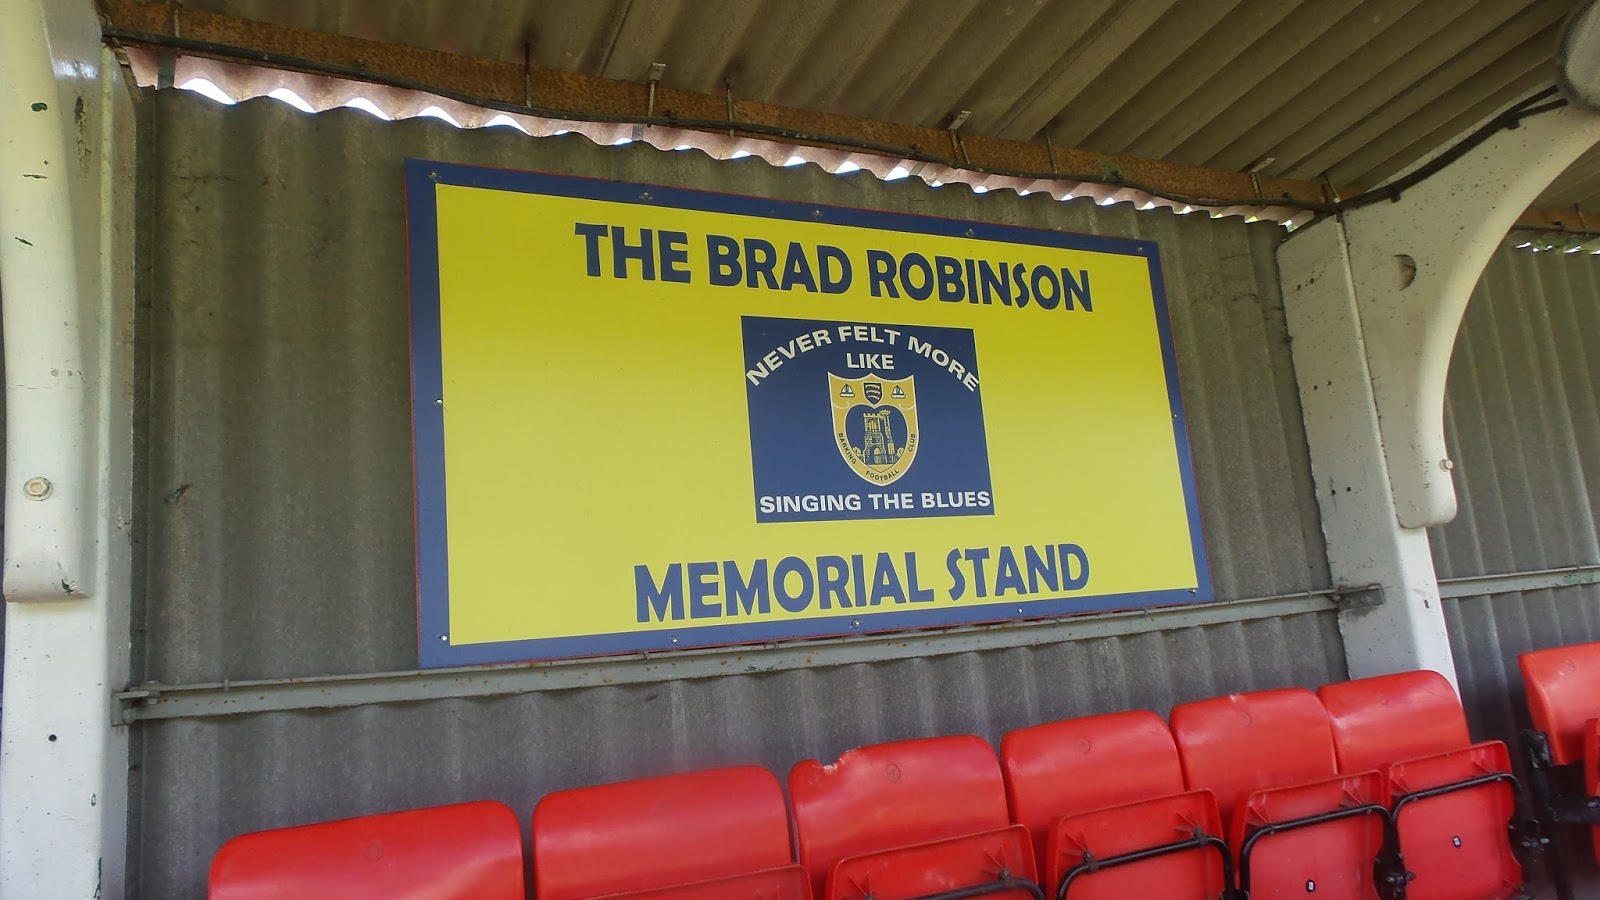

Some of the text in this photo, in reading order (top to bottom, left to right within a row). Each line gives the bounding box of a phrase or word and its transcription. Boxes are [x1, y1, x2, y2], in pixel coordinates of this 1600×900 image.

[574, 222, 1094, 312] THE BRAD ROBINSON
[745, 325, 980, 392] NEVER FELT MORE
[846, 352, 895, 370] LIKE
[838, 432, 916, 481] BARKING FOOTBALL CLUB
[759, 491, 991, 513] SINGING THE BLUES
[634, 543, 1091, 623] MEMORIAL STAND
